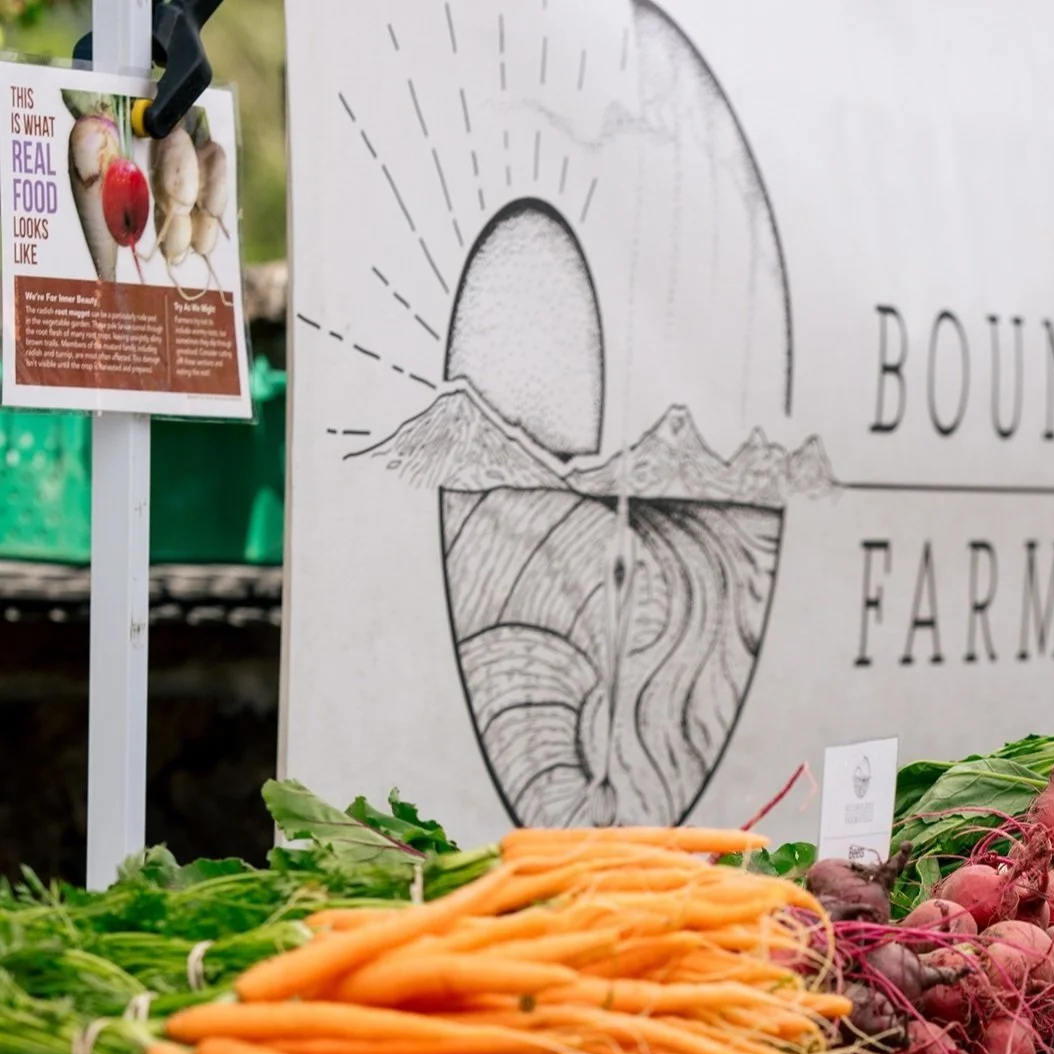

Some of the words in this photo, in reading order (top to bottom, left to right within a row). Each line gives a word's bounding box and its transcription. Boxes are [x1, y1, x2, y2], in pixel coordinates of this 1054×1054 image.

[10, 86, 34, 109] THIS
[11, 113, 21, 135] IS
[23, 114, 55, 138] WHAT
[12, 140, 57, 176] REAL
[13, 178, 58, 214] FOOD
[13, 216, 49, 240] LOOKS
[14, 243, 38, 265] LIKE
[25, 290, 45, 301] We're
[46, 292, 57, 302] For
[59, 293, 75, 303] Inner
[26, 305, 36, 314] The
[37, 306, 54, 315] radish
[55, 308, 68, 316] root
[69, 309, 90, 318] maggot
[25, 327, 35, 335] the
[42, 319, 70, 328] vegetable
[26, 348, 42, 356] radish
